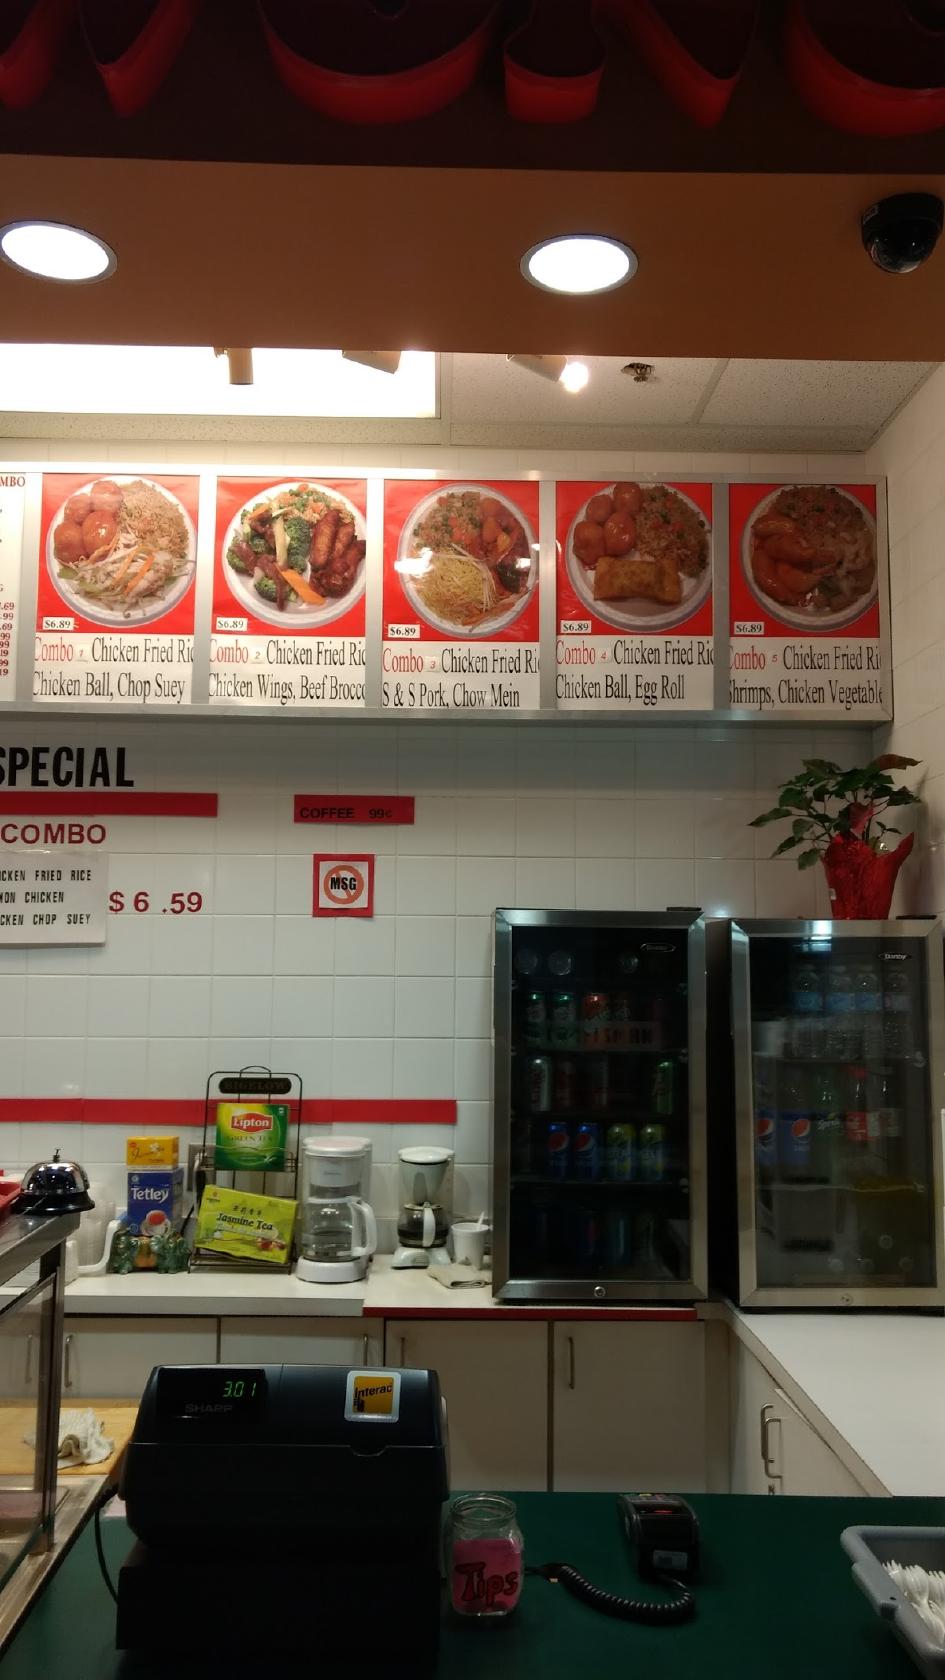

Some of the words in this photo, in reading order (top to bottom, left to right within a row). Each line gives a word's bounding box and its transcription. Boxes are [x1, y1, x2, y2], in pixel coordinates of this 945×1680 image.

[44, 618, 71, 629] $6.89
[217, 619, 245, 629] $6.89
[389, 626, 417, 636] $6.89
[563, 622, 590, 632] $6.89
[736, 623, 762, 634] $6.89
[92, 636, 141, 663] Chicken
[143, 637, 175, 663] Fried
[266, 639, 313, 666] Chicken
[316, 640, 346, 666] Fried
[556, 640, 596, 665] Combo
[600, 651, 608, 661] 4
[613, 640, 661, 665] Chicken
[664, 640, 694, 666] Fried
[783, 645, 831, 670] Chicken
[833, 645, 863, 671] Fried
[866, 645, 882, 671] Ri
[383, 647, 424, 673] Combo
[429, 659, 437, 670] 3
[441, 648, 488, 674] Chicken
[491, 648, 522, 674] Fried
[85, 671, 114, 701] Ball,
[117, 672, 152, 704] Chop
[154, 671, 185, 704] Suey
[256, 673, 296, 705] Wings,
[300, 675, 329, 700] Beef
[382, 682, 390, 707] S
[393, 681, 405, 706] &
[408, 682, 416, 707] S
[419, 682, 450, 709] Pork,
[453, 682, 488, 708] Chow
[490, 683, 521, 708] Mein
[555, 673, 601, 699] Chicken
[604, 674, 632, 704] Ball,
[635, 675, 659, 707] Egg
[661, 675, 685, 700] Roll
[778, 679, 825, 704] Chicken
[299, 807, 355, 819] COFFEE
[0, 823, 107, 844] COMBO
[35, 869, 62, 882] FRIED
[70, 869, 92, 881] RICE
[329, 876, 357, 891] MSG
[24, 891, 65, 904] CHICKEN
[33, 913, 57, 926] CHOP
[66, 913, 92, 925] SUEY
[233, 1117, 270, 1130] Lipton
[130, 1187, 170, 1204] Tetley
[216, 1212, 255, 1228] Jasmine
[256, 1220, 274, 1231] Tea
[223, 1380, 257, 1399] 3.01
[455, 1561, 519, 1608] Tips
